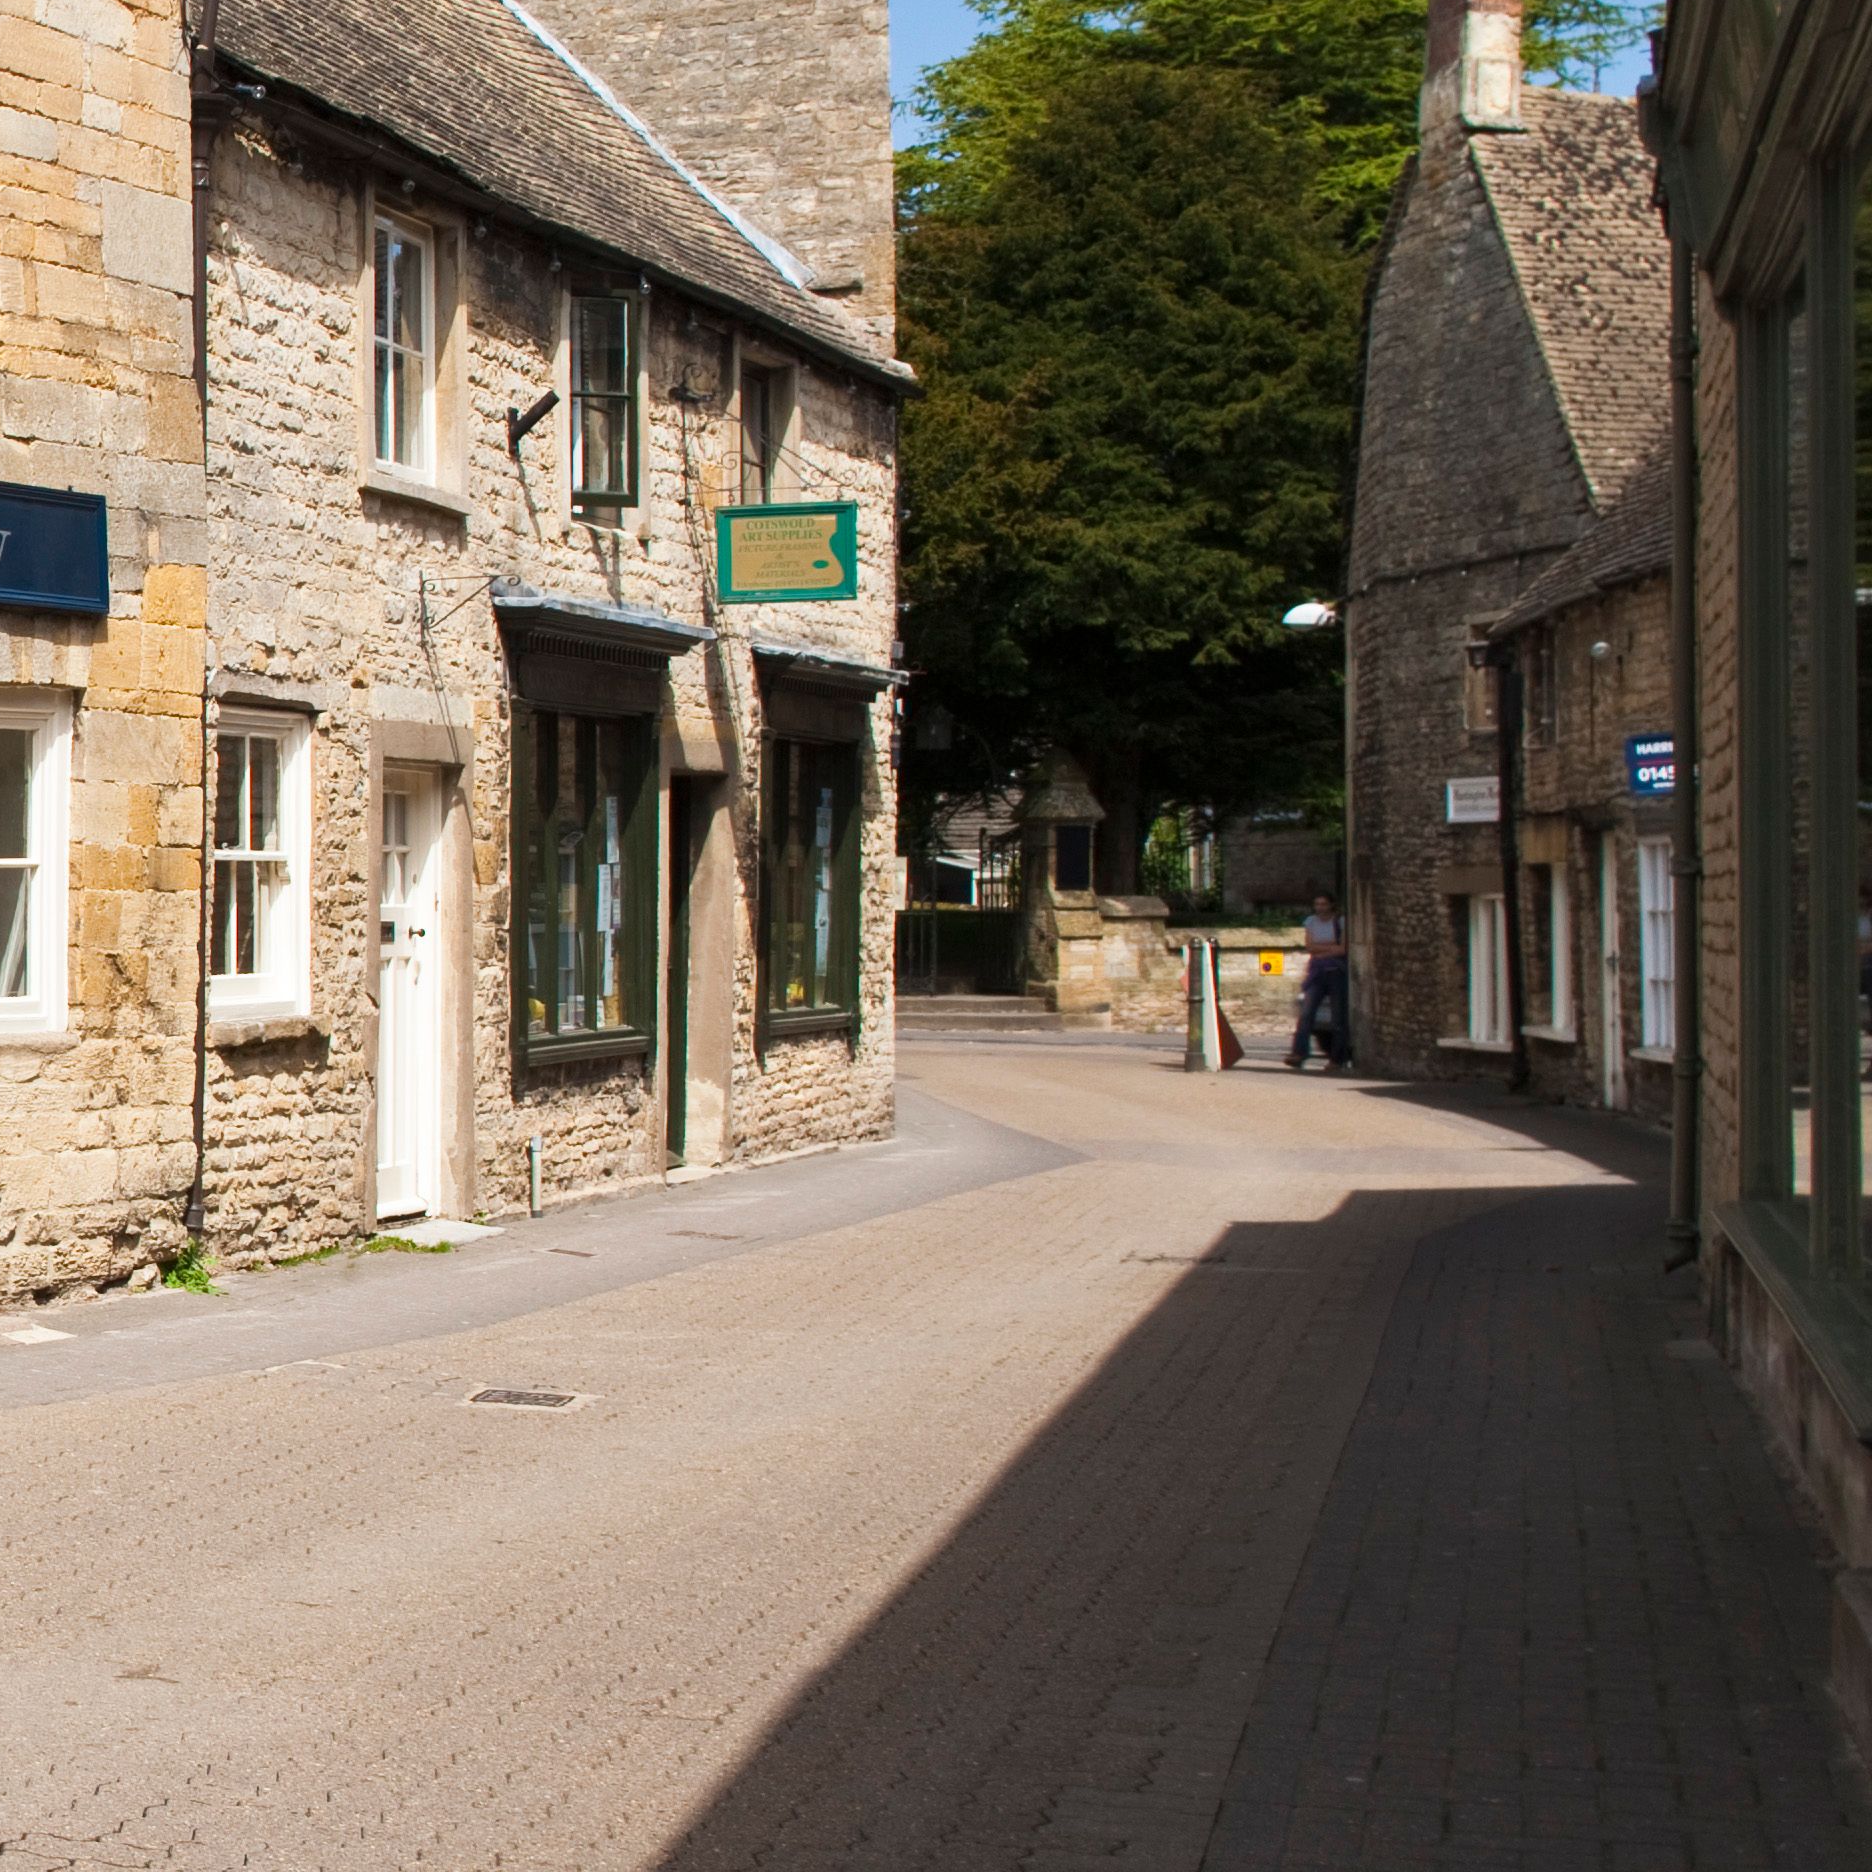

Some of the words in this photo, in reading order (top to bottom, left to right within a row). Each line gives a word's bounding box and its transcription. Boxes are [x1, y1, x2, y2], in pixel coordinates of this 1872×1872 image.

[746, 518, 816, 530] COTSWOLD
[740, 531, 762, 543] ART
[766, 528, 824, 541] SUPPLIES
